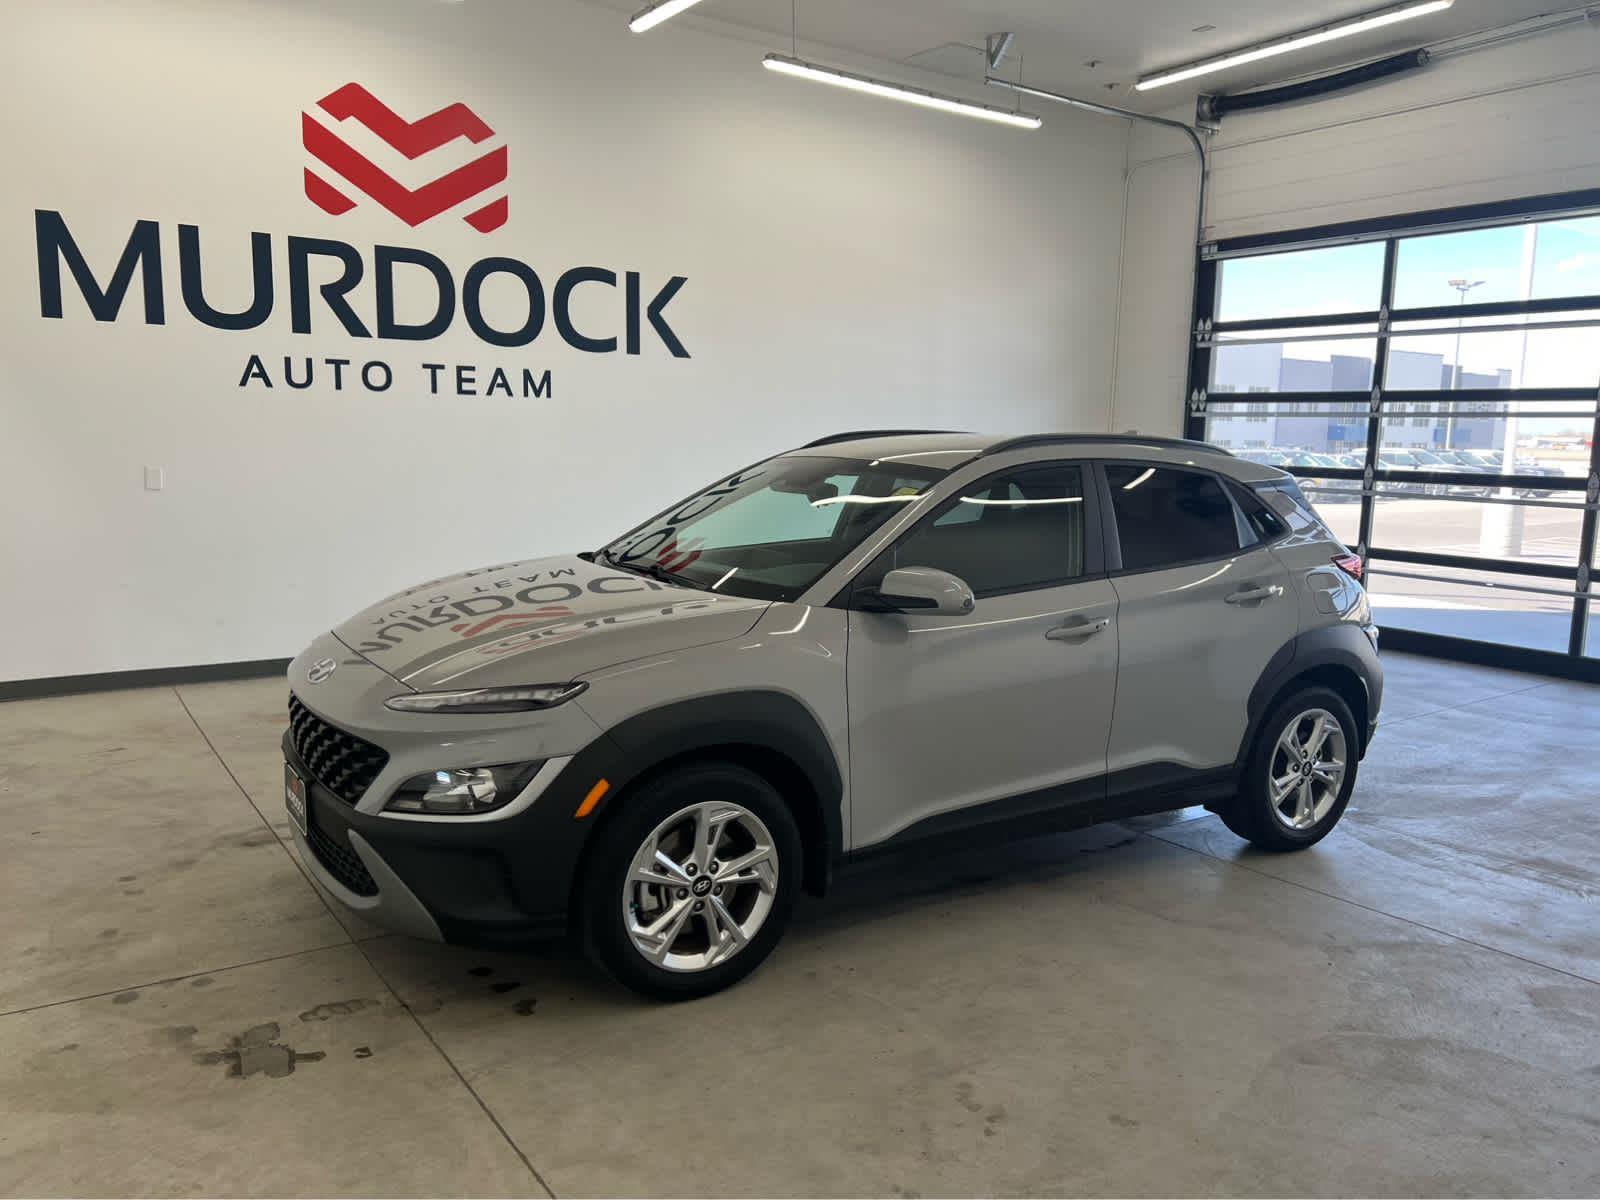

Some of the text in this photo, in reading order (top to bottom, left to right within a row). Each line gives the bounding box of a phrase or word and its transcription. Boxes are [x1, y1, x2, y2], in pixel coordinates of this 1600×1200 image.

[34, 209, 691, 359] MURDOCK
[238, 354, 552, 399] AUTO TEAM
